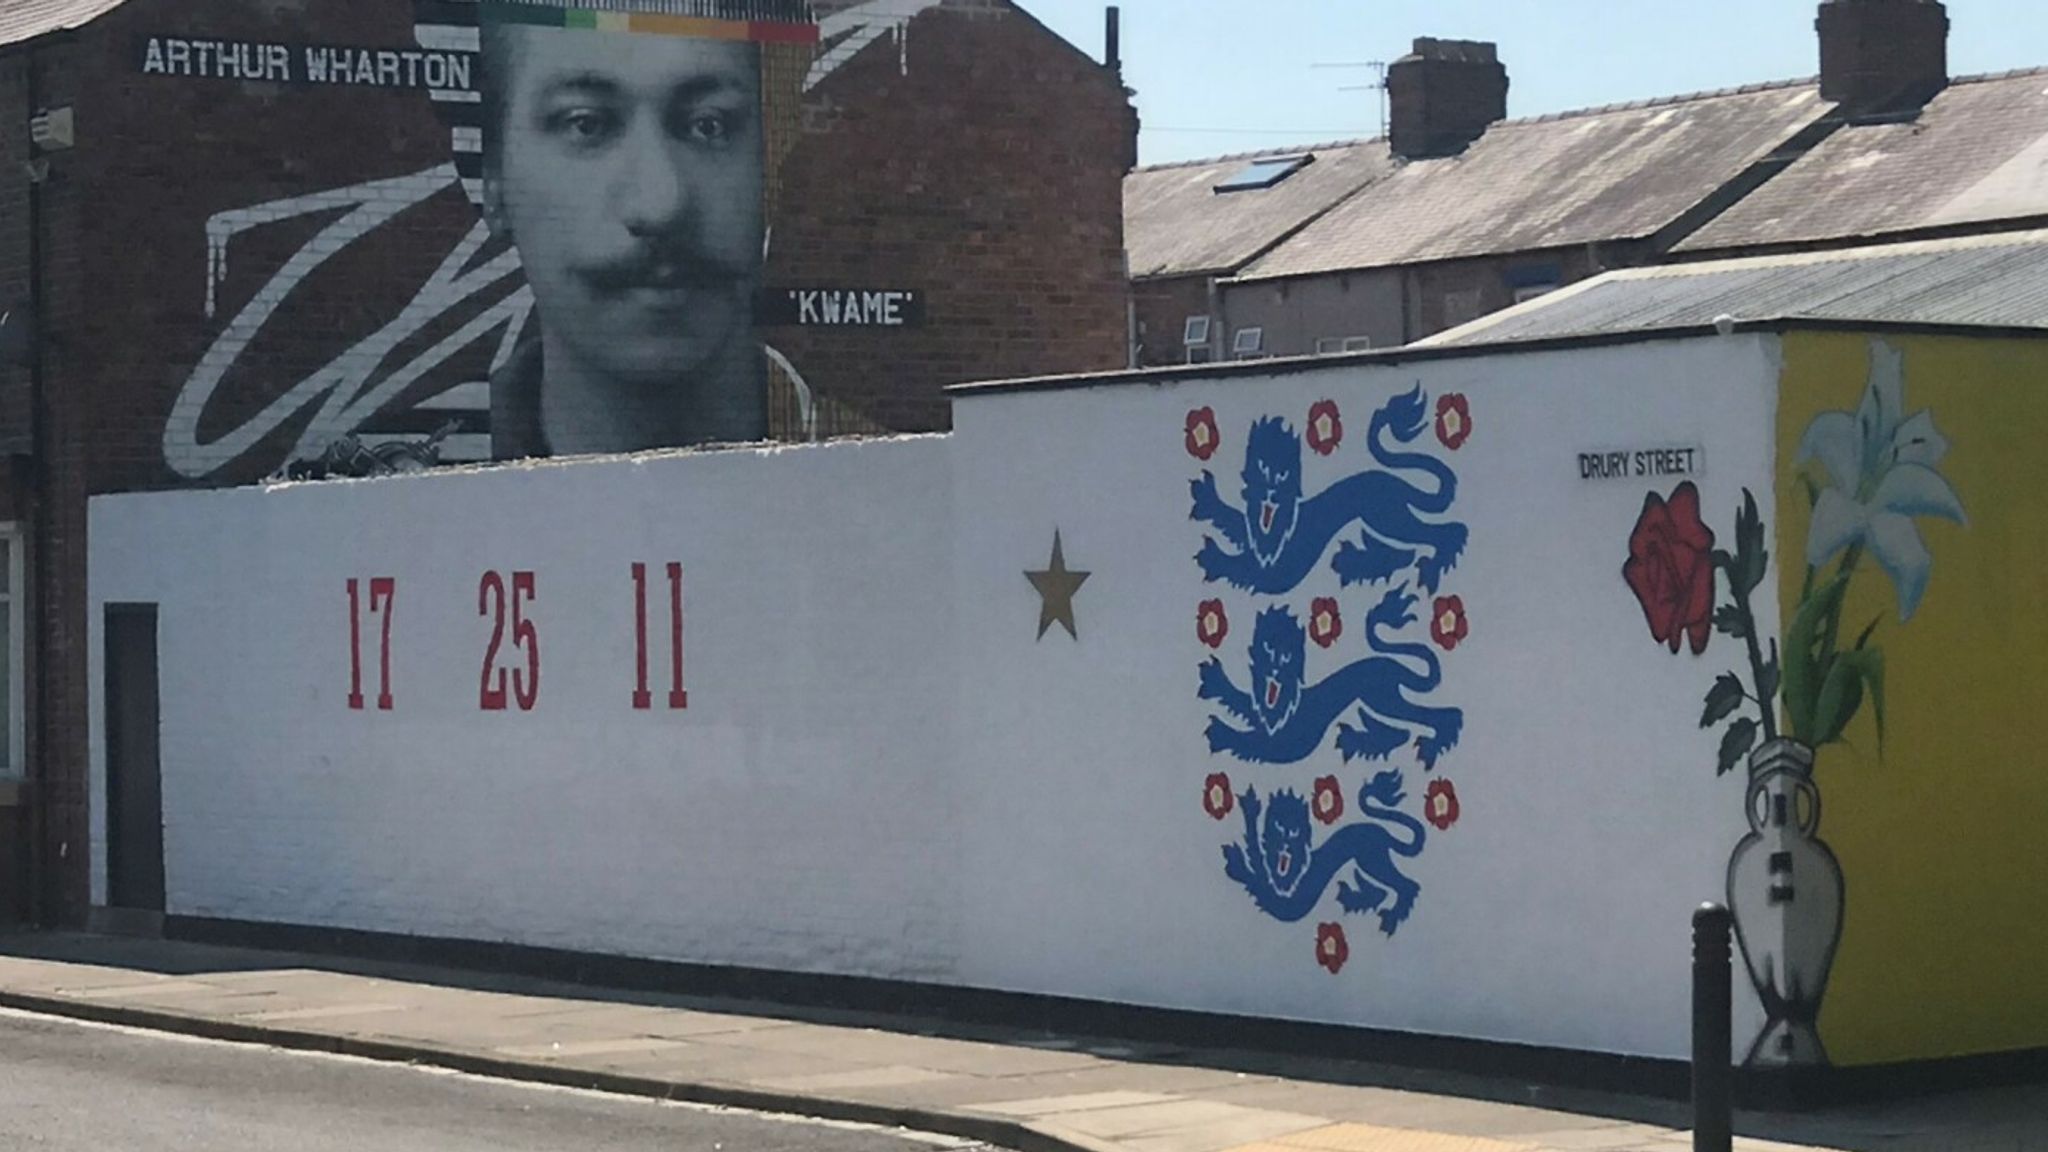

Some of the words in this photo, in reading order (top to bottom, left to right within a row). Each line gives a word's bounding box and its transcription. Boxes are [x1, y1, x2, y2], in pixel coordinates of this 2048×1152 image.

[143, 38, 290, 81] ARTHUR
[305, 47, 471, 89] WHARTON
[1578, 452, 1630, 479] DRURY
[1635, 448, 1694, 476] STREET
[346, 577, 395, 710] 17
[479, 569, 539, 711] 25
[631, 561, 687, 710] 11
